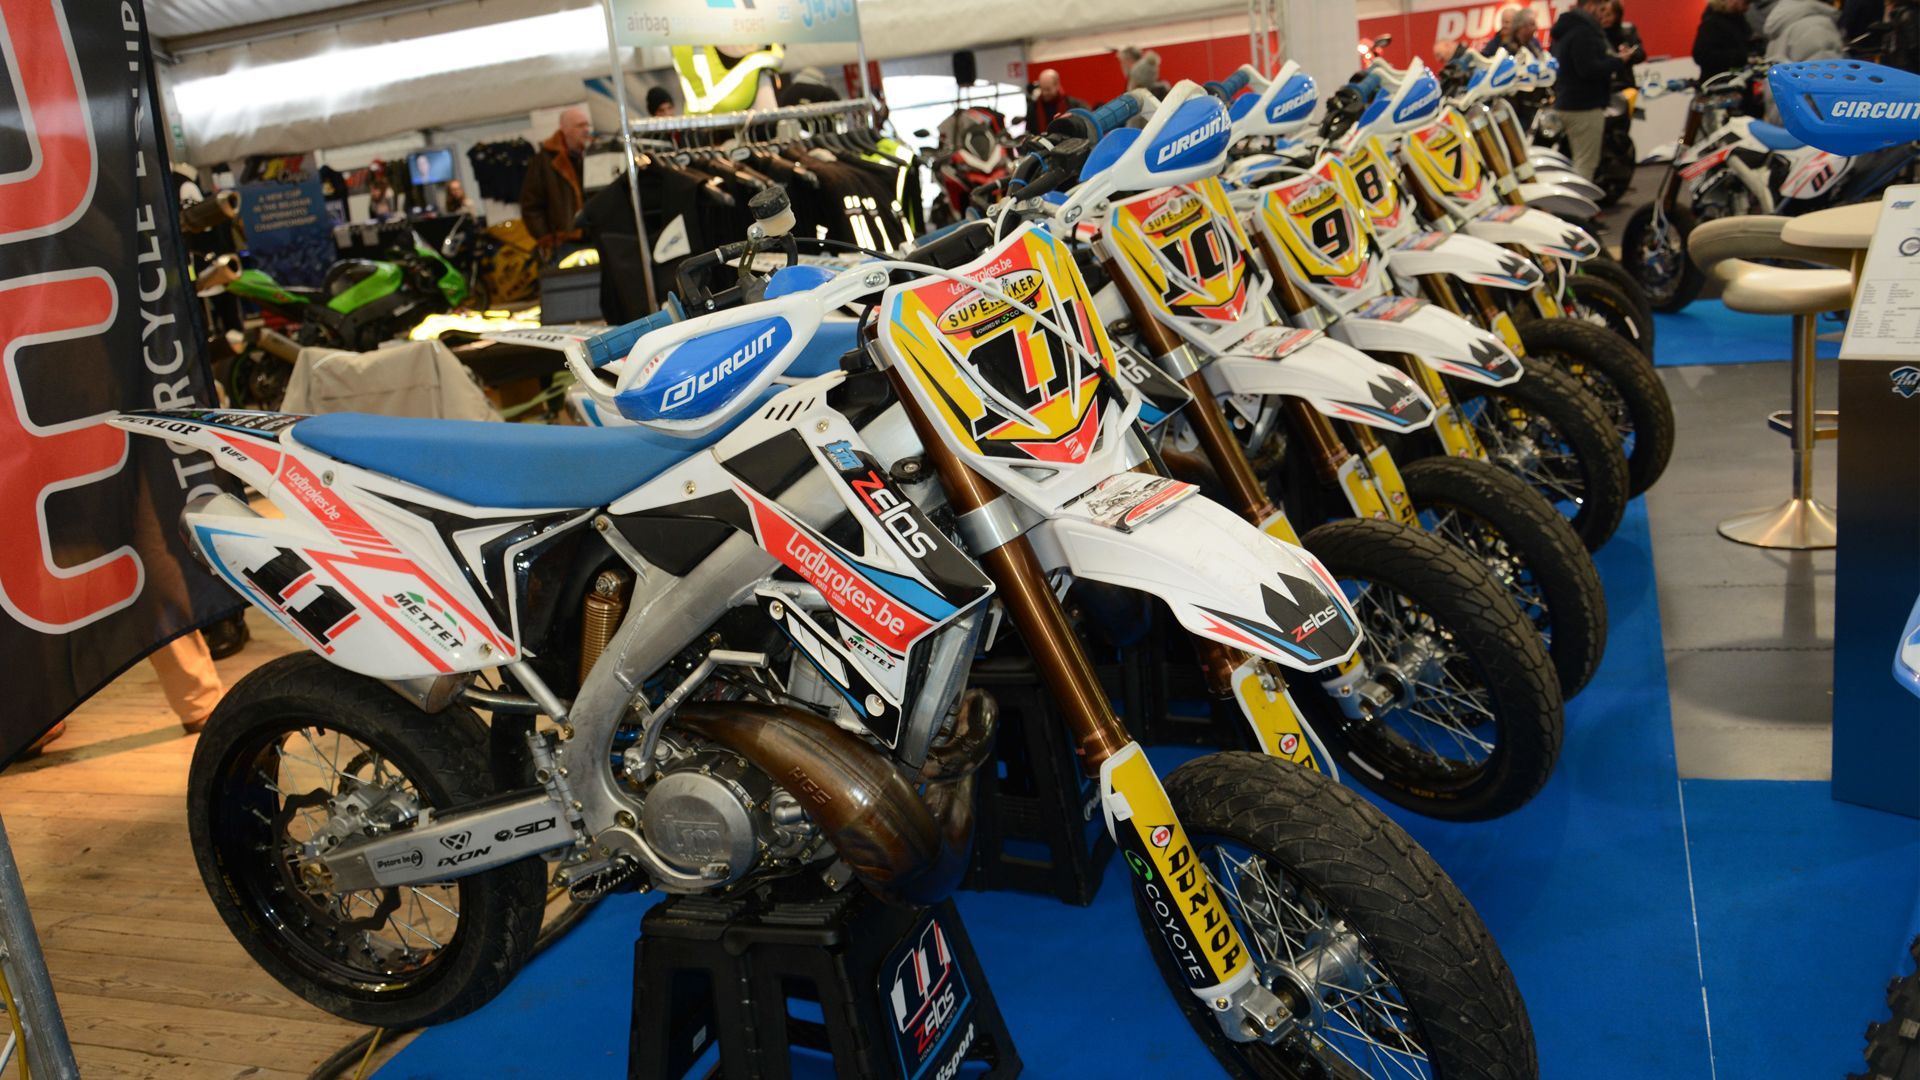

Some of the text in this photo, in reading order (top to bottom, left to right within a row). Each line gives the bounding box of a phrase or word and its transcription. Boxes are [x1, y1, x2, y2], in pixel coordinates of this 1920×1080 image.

[627, 15, 670, 36] airbag
[1157, 116, 1222, 165] CIRCUIT
[1445, 144, 1463, 179] 7
[1355, 164, 1385, 204] 8
[1312, 208, 1350, 259] 9
[1160, 218, 1242, 307] 10
[698, 326, 776, 394] CIRCUIT
[967, 296, 1103, 442] 11
[118, 416, 202, 436] DUNLOP
[286, 465, 340, 521] Ladbrokes.be
[241, 546, 359, 650] 11
[785, 531, 906, 636] Ladbrokes.be
[393, 592, 464, 649] METTET
[848, 636, 896, 670] METTET
[514, 816, 557, 839] SIDI
[1145, 883, 1206, 980] COYOTE
[1168, 844, 1241, 974] DUNLOP
[890, 918, 952, 1034] 11
